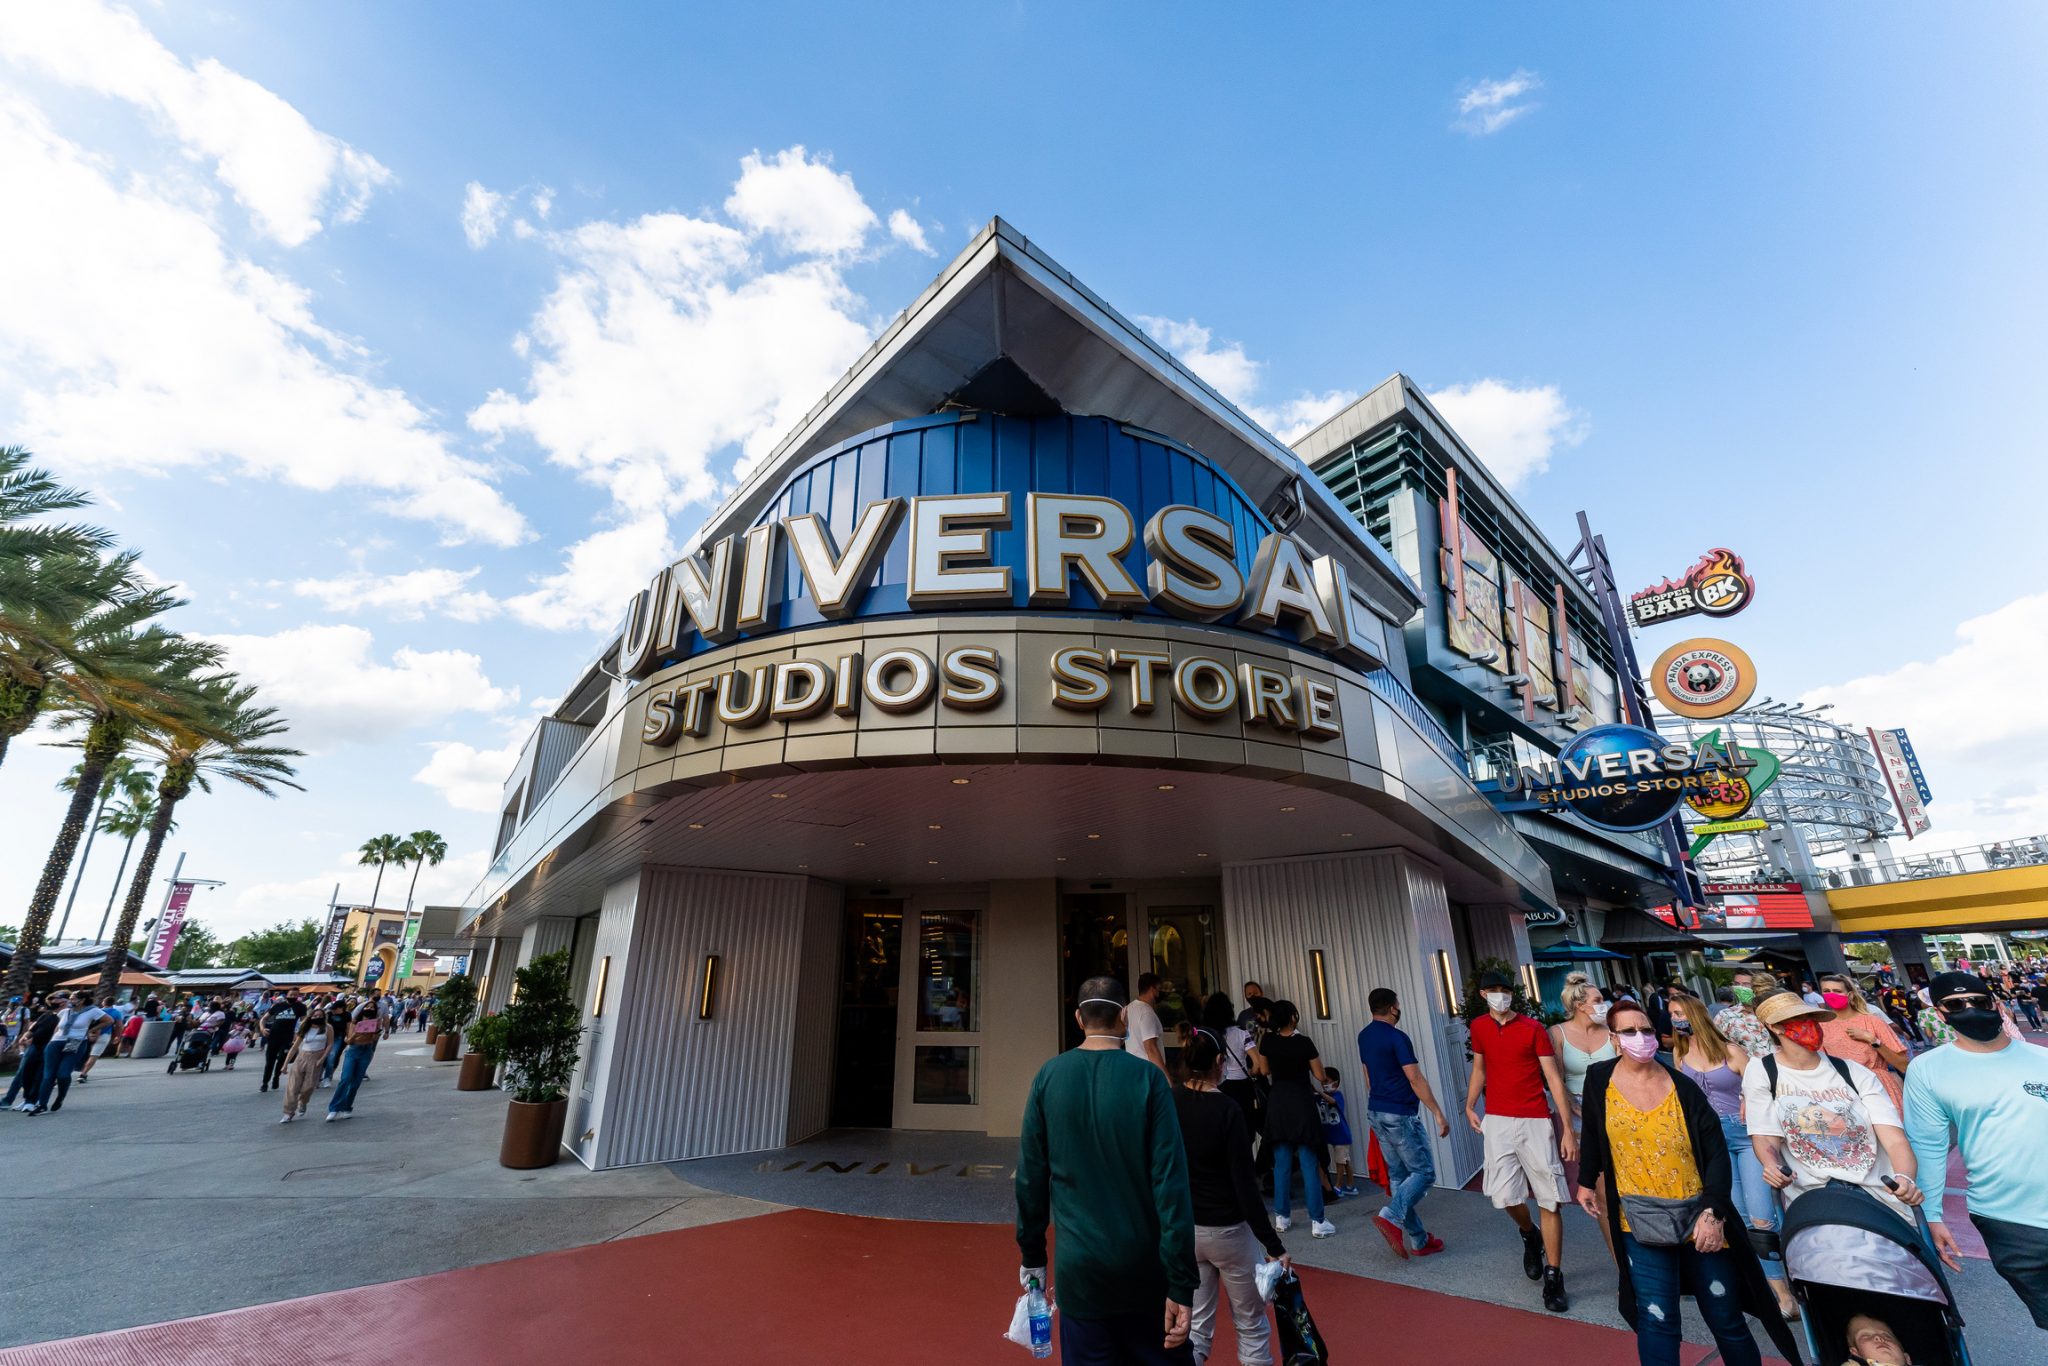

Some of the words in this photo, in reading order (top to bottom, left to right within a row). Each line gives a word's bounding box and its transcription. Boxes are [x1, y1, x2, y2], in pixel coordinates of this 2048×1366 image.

[617, 491, 1383, 679] UNIVERSAL
[1634, 587, 1691, 606] WHOPPER
[1702, 575, 1738, 606] BK
[1637, 594, 1696, 620] BAR
[1669, 656, 1691, 684] PANDA
[1691, 651, 1733, 672] EXPRESS
[641, 645, 1003, 748] STUDIOS
[1050, 647, 1342, 740] STORE
[1672, 686, 1699, 702] GOURMET
[1700, 689, 1726, 702] CHINESE
[1725, 675, 1735, 691] FOOD
[1497, 741, 1758, 794] UNIVERSAL
[1881, 732, 1925, 829] CINEMARK
[1896, 730, 1930, 800] UNIVERSAL
[1539, 783, 1628, 805] STUDIOS
[1637, 774, 1715, 793] STORE
[1694, 781, 1744, 806] OE'S
[1698, 823, 1739, 833] southwest
[1742, 820, 1761, 831] grill
[1718, 884, 1786, 892] CINEMARK
[173, 902, 187, 925] TRUE
[147, 909, 176, 964] ITALIAN
[326, 919, 345, 966] RESTAURANT
[753, 1160, 1016, 1179] UNIVE
